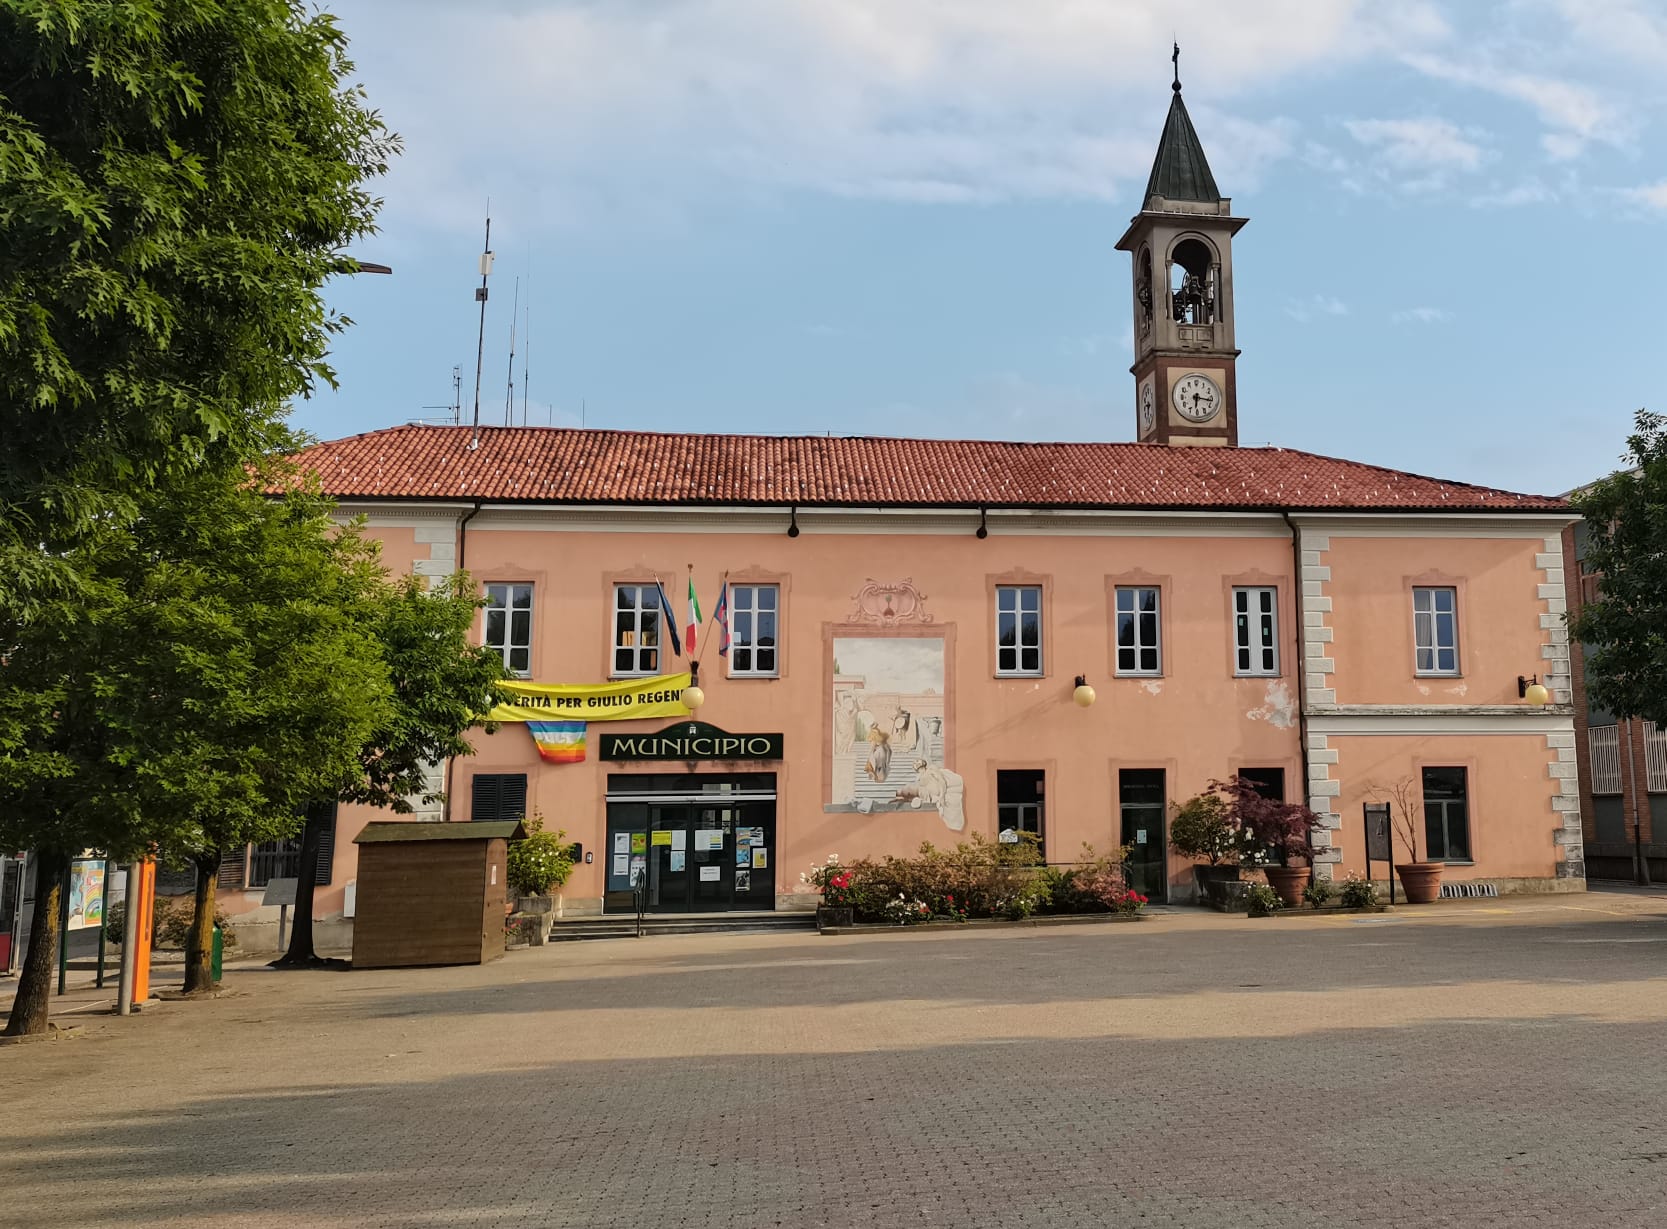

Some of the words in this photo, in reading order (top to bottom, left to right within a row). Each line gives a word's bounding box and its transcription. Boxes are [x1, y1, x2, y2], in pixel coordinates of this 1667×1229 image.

[556, 697, 582, 708] PER
[587, 694, 633, 708] GIULIO
[637, 689, 685, 704] REGEN
[611, 737, 772, 756] MUNICIPIO
